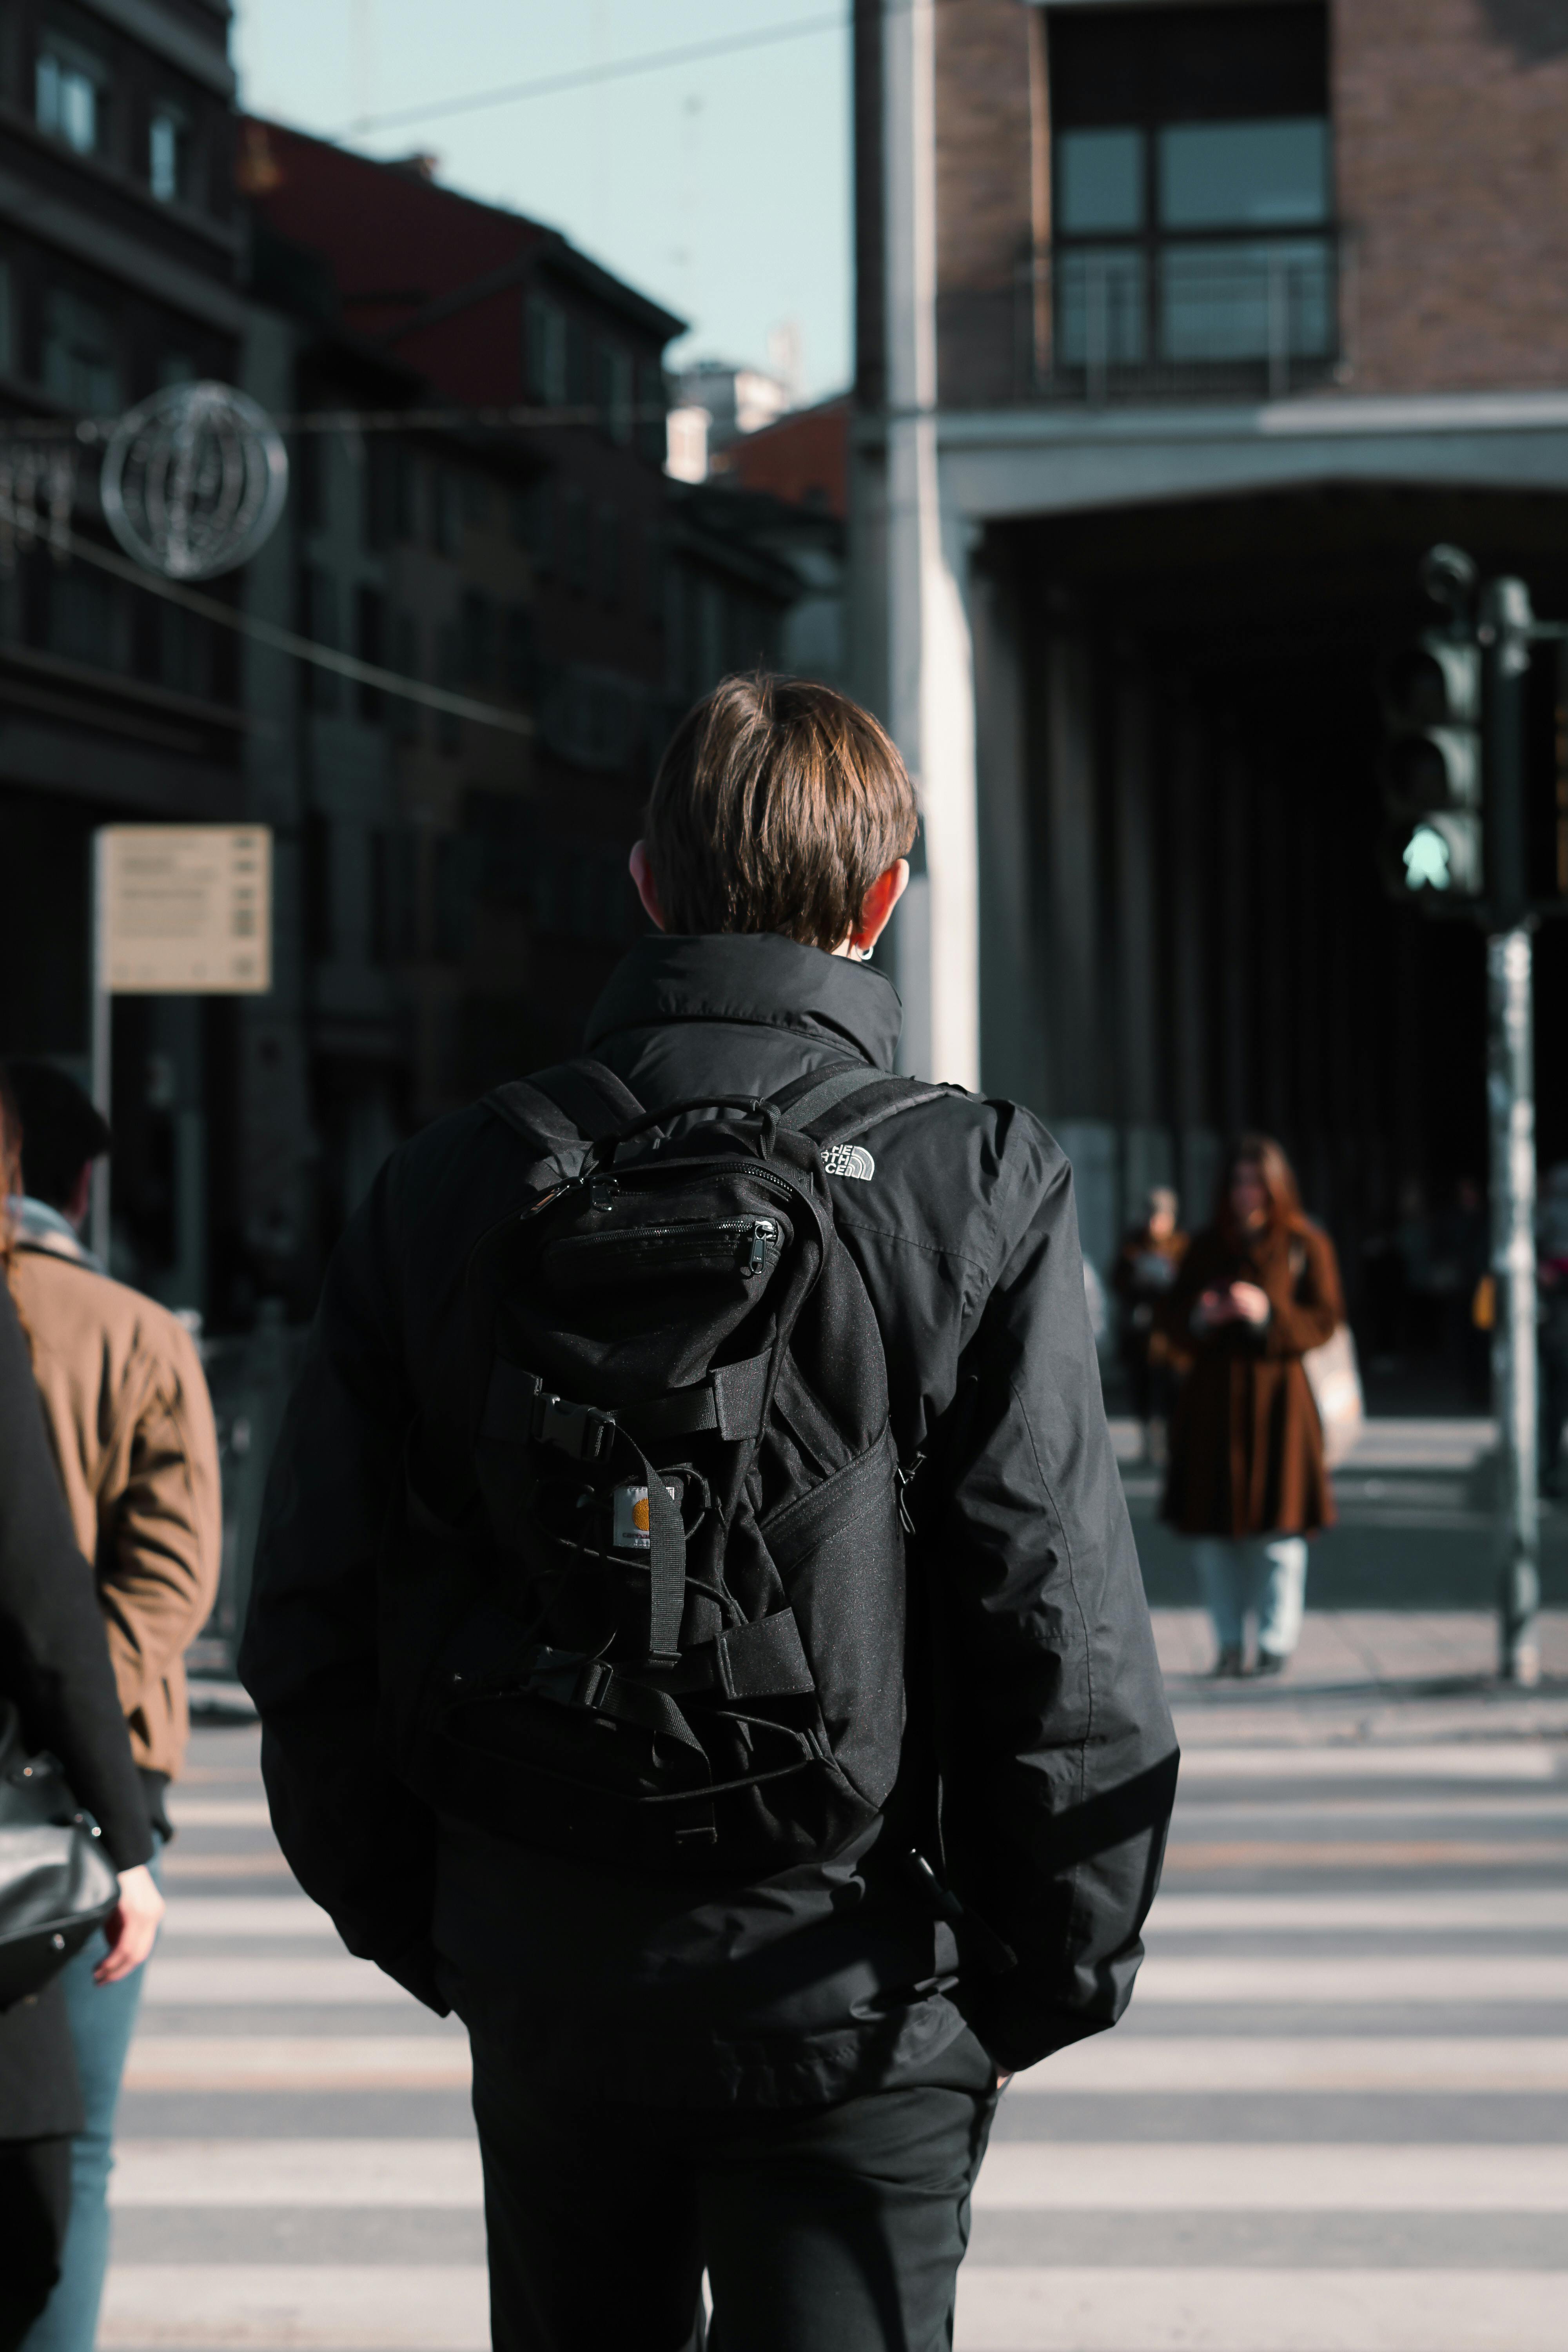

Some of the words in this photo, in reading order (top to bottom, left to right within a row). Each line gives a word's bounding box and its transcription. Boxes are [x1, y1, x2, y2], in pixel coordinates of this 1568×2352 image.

[832, 1144, 853, 1155] HE
[820, 1151, 850, 1166] RTH
[825, 1163, 847, 1176] CE
